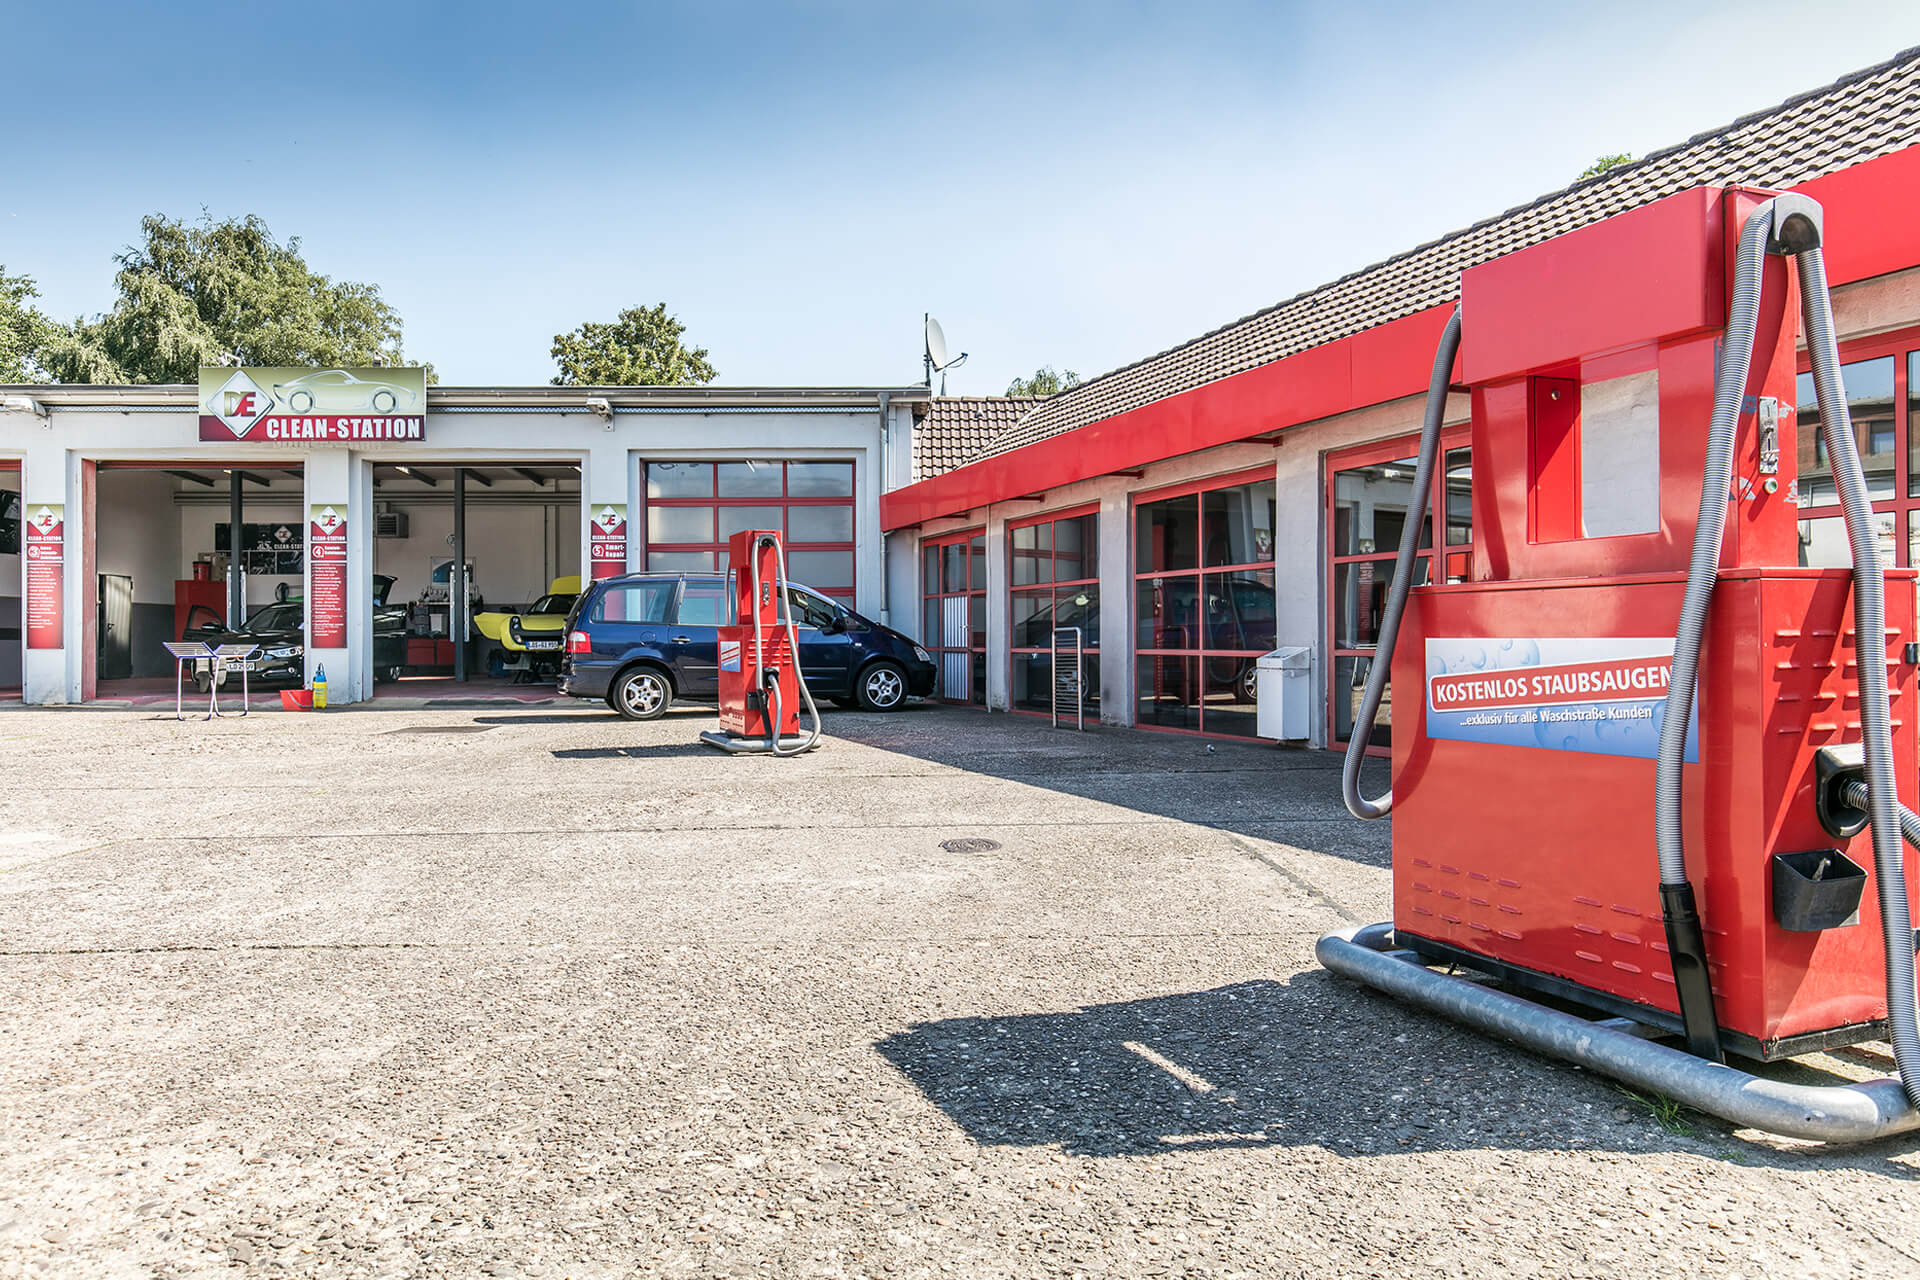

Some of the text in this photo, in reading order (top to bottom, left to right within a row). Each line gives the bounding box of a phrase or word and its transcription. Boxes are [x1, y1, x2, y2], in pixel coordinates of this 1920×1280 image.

[266, 418, 420, 439] CLEAN-STATION
[1436, 677, 1528, 703] KOSTENLOS
[1504, 711, 1519, 724] für
[1521, 711, 1538, 724] alle
[1540, 707, 1606, 722] Waschstraße
[1608, 705, 1652, 720] Kunden
